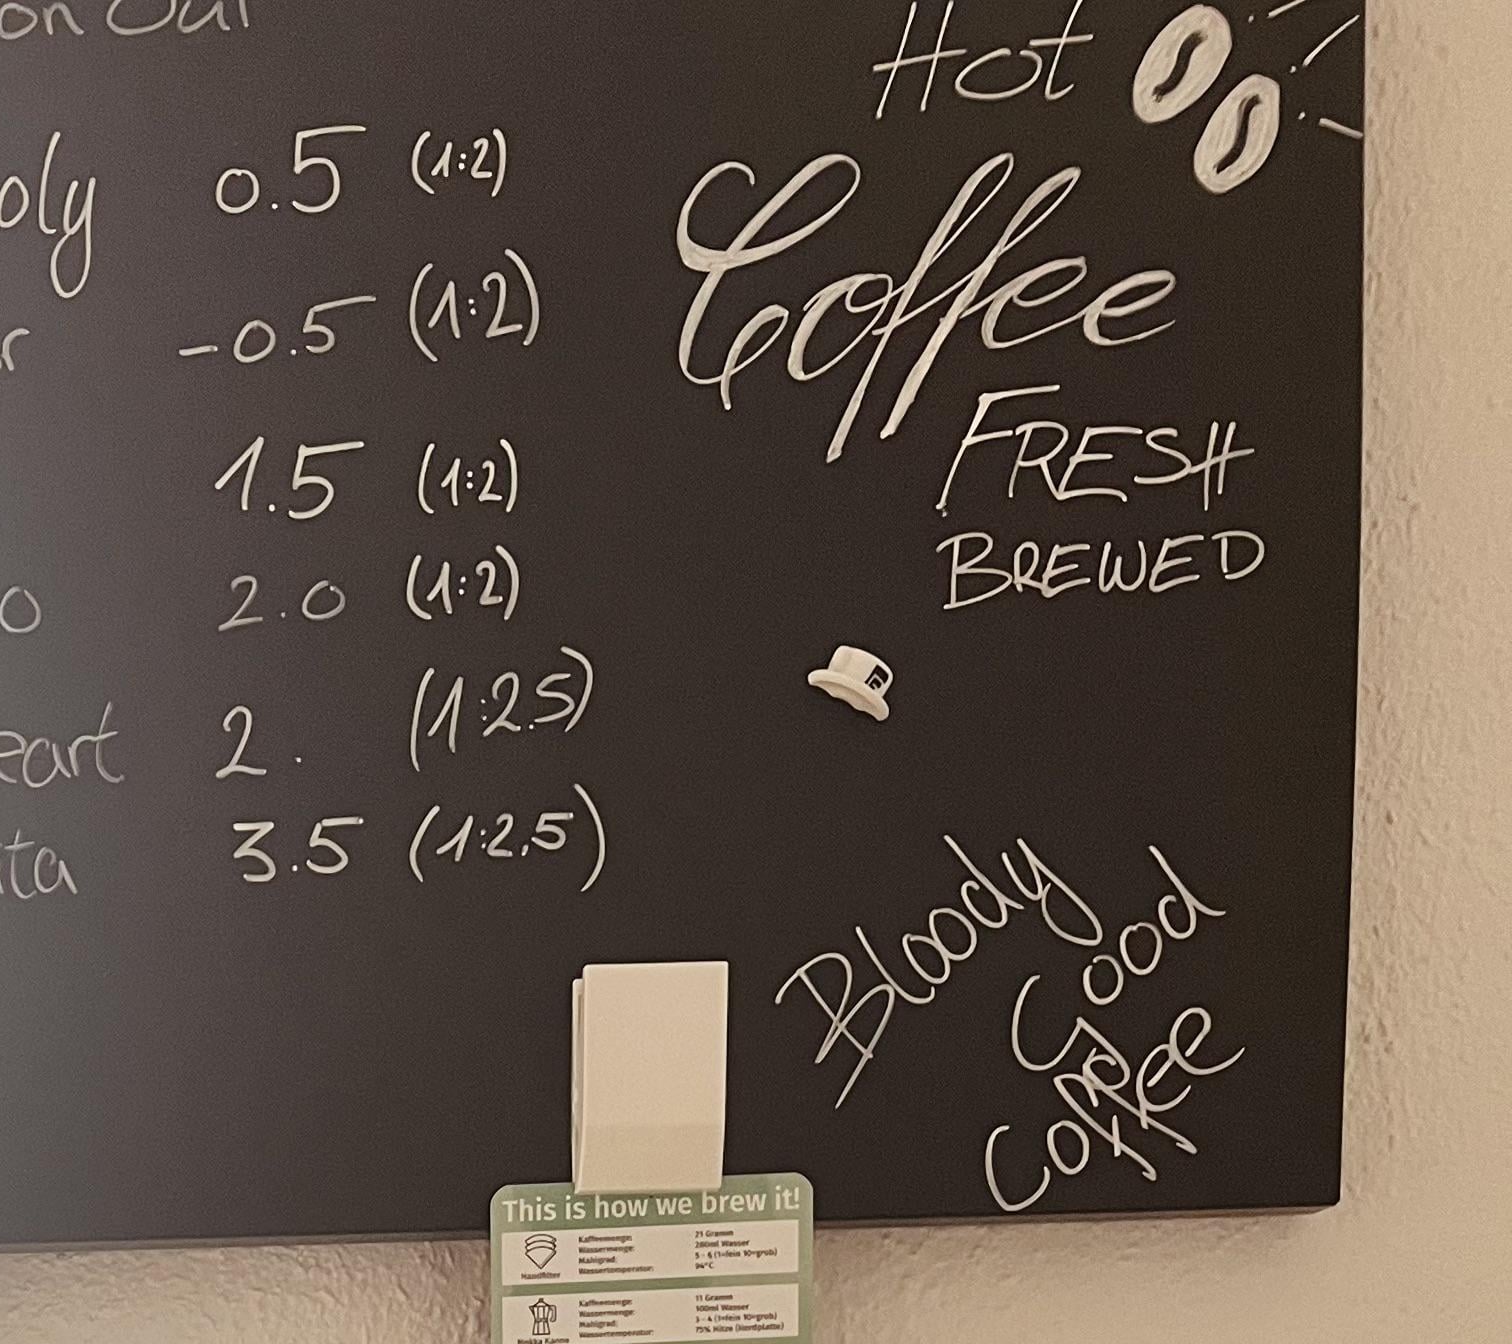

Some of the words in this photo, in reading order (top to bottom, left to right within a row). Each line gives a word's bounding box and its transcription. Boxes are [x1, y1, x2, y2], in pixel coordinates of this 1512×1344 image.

[873, 0, 1093, 119] Hot
[215, 125, 367, 214] 0.5
[411, 128, 507, 197] (1:2)
[409, 248, 541, 362] (1:2)
[676, 152, 1177, 464] Coffee
[214, 436, 365, 520] 1.5
[417, 438, 519, 514] (1:2)
[936, 385, 1255, 513] FRESH
[218, 574, 346, 632] 2.0
[406, 544, 520, 620] (1:2)
[936, 531, 1266, 611] BREWED
[233, 816, 364, 882] 3.5
[774, 834, 1103, 1109] Bloody
[1011, 844, 1227, 1092] Good
[984, 1007, 1246, 1212] Coffee
[502, 1196, 557, 1222] This
[565, 1195, 586, 1220] is
[594, 1193, 648, 1218] how
[656, 1196, 692, 1216] we
[701, 1191, 767, 1214] brew
[775, 1185, 800, 1210] it!
